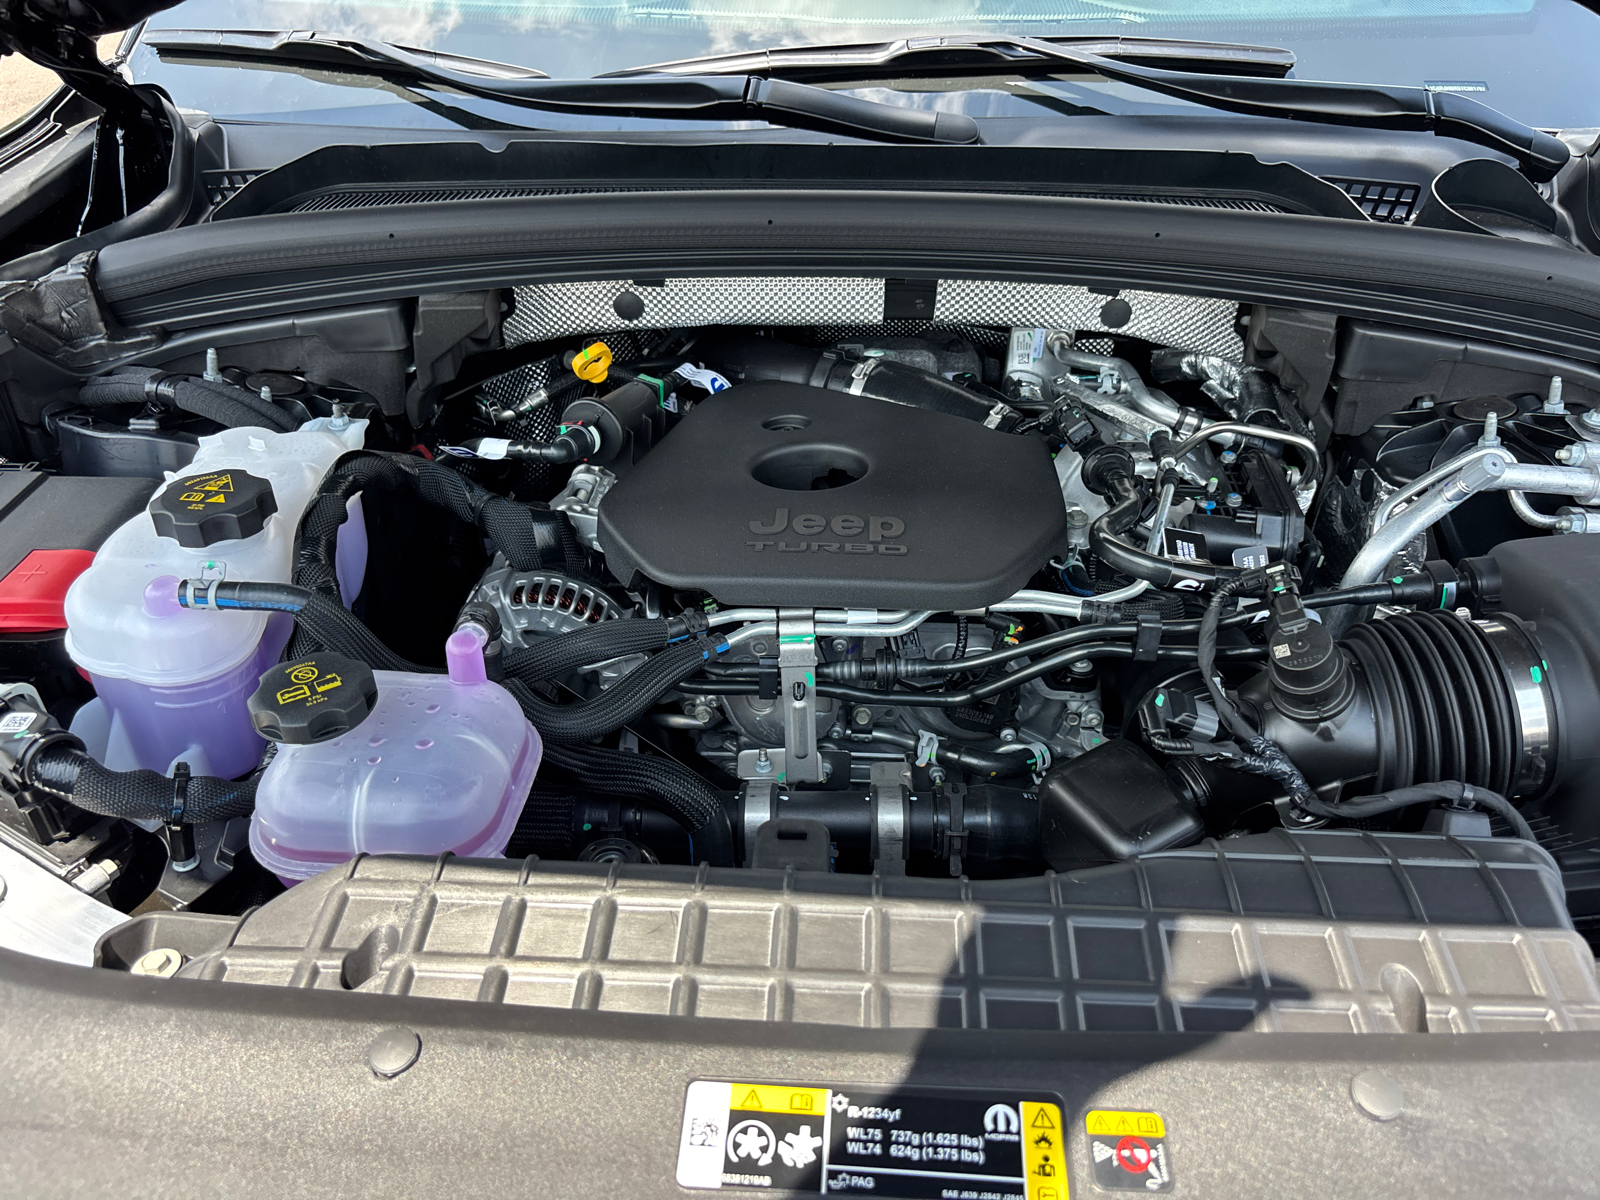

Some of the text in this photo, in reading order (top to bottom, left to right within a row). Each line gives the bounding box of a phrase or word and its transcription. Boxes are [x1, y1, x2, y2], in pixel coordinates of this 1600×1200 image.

[749, 507, 905, 543] Jeep
[745, 541, 908, 556] TURBO
[847, 1105, 901, 1122] R-1234yf
[846, 1127, 985, 1149] WL75 737g (1.625 lbs)
[984, 1132, 1020, 1143] MOPAR
[846, 1141, 986, 1165] WL74 624g (1.375 lbs)
[851, 1175, 876, 1189] PAG
[942, 1188, 958, 1199] SAE
